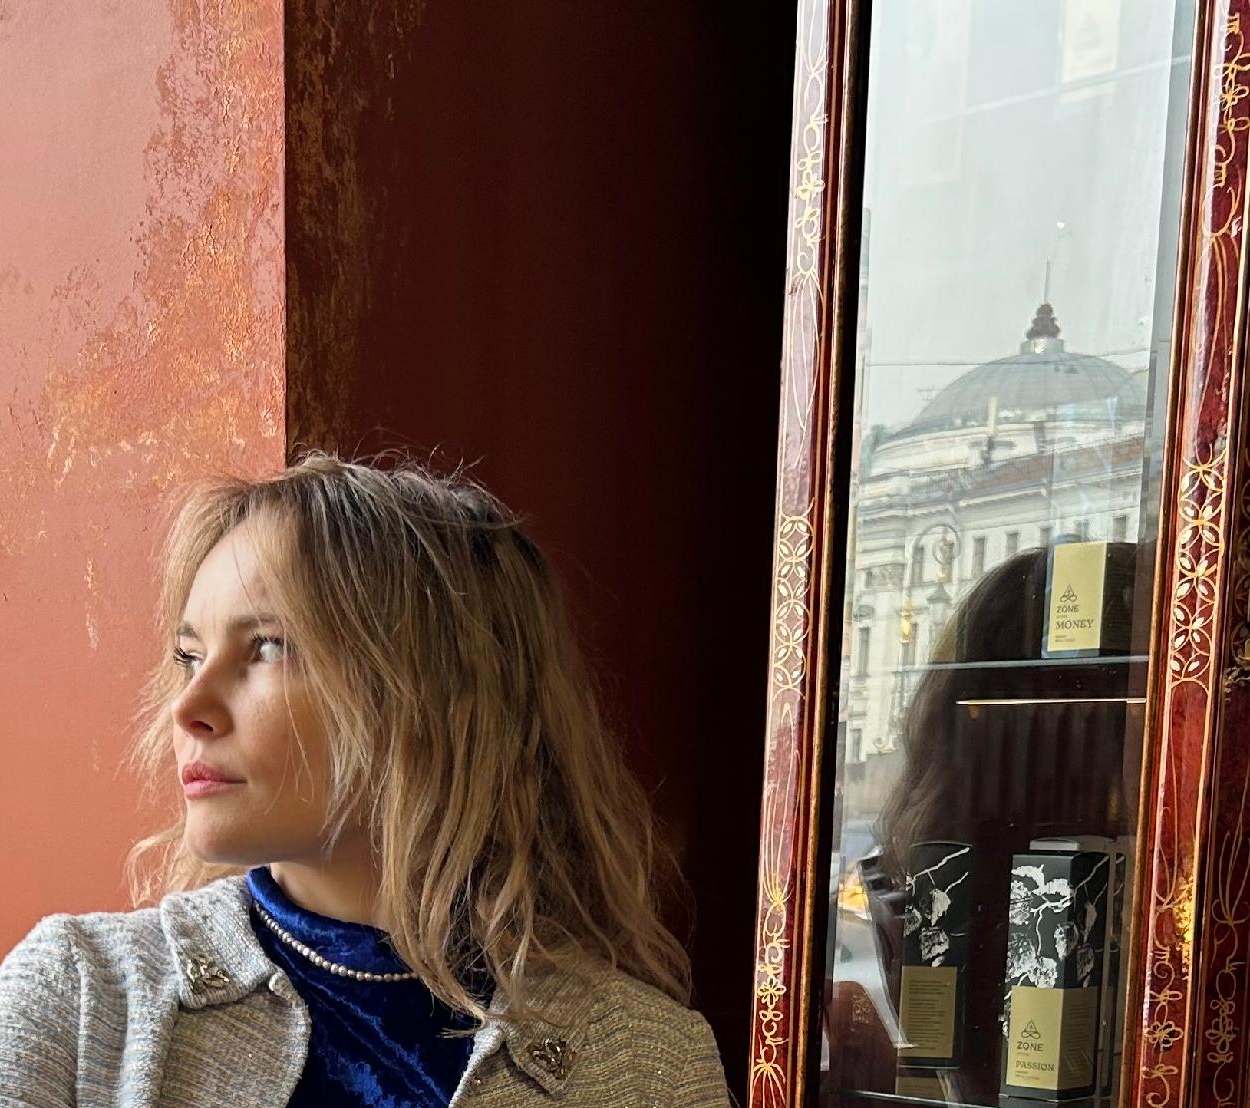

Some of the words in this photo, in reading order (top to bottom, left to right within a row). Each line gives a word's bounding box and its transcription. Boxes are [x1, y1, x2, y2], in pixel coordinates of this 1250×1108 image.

[1056, 604, 1079, 613] ZONE
[1055, 619, 1094, 630] MONEY
[1016, 1041, 1045, 1052] ZONE
[1015, 1060, 1055, 1071] PASSION
